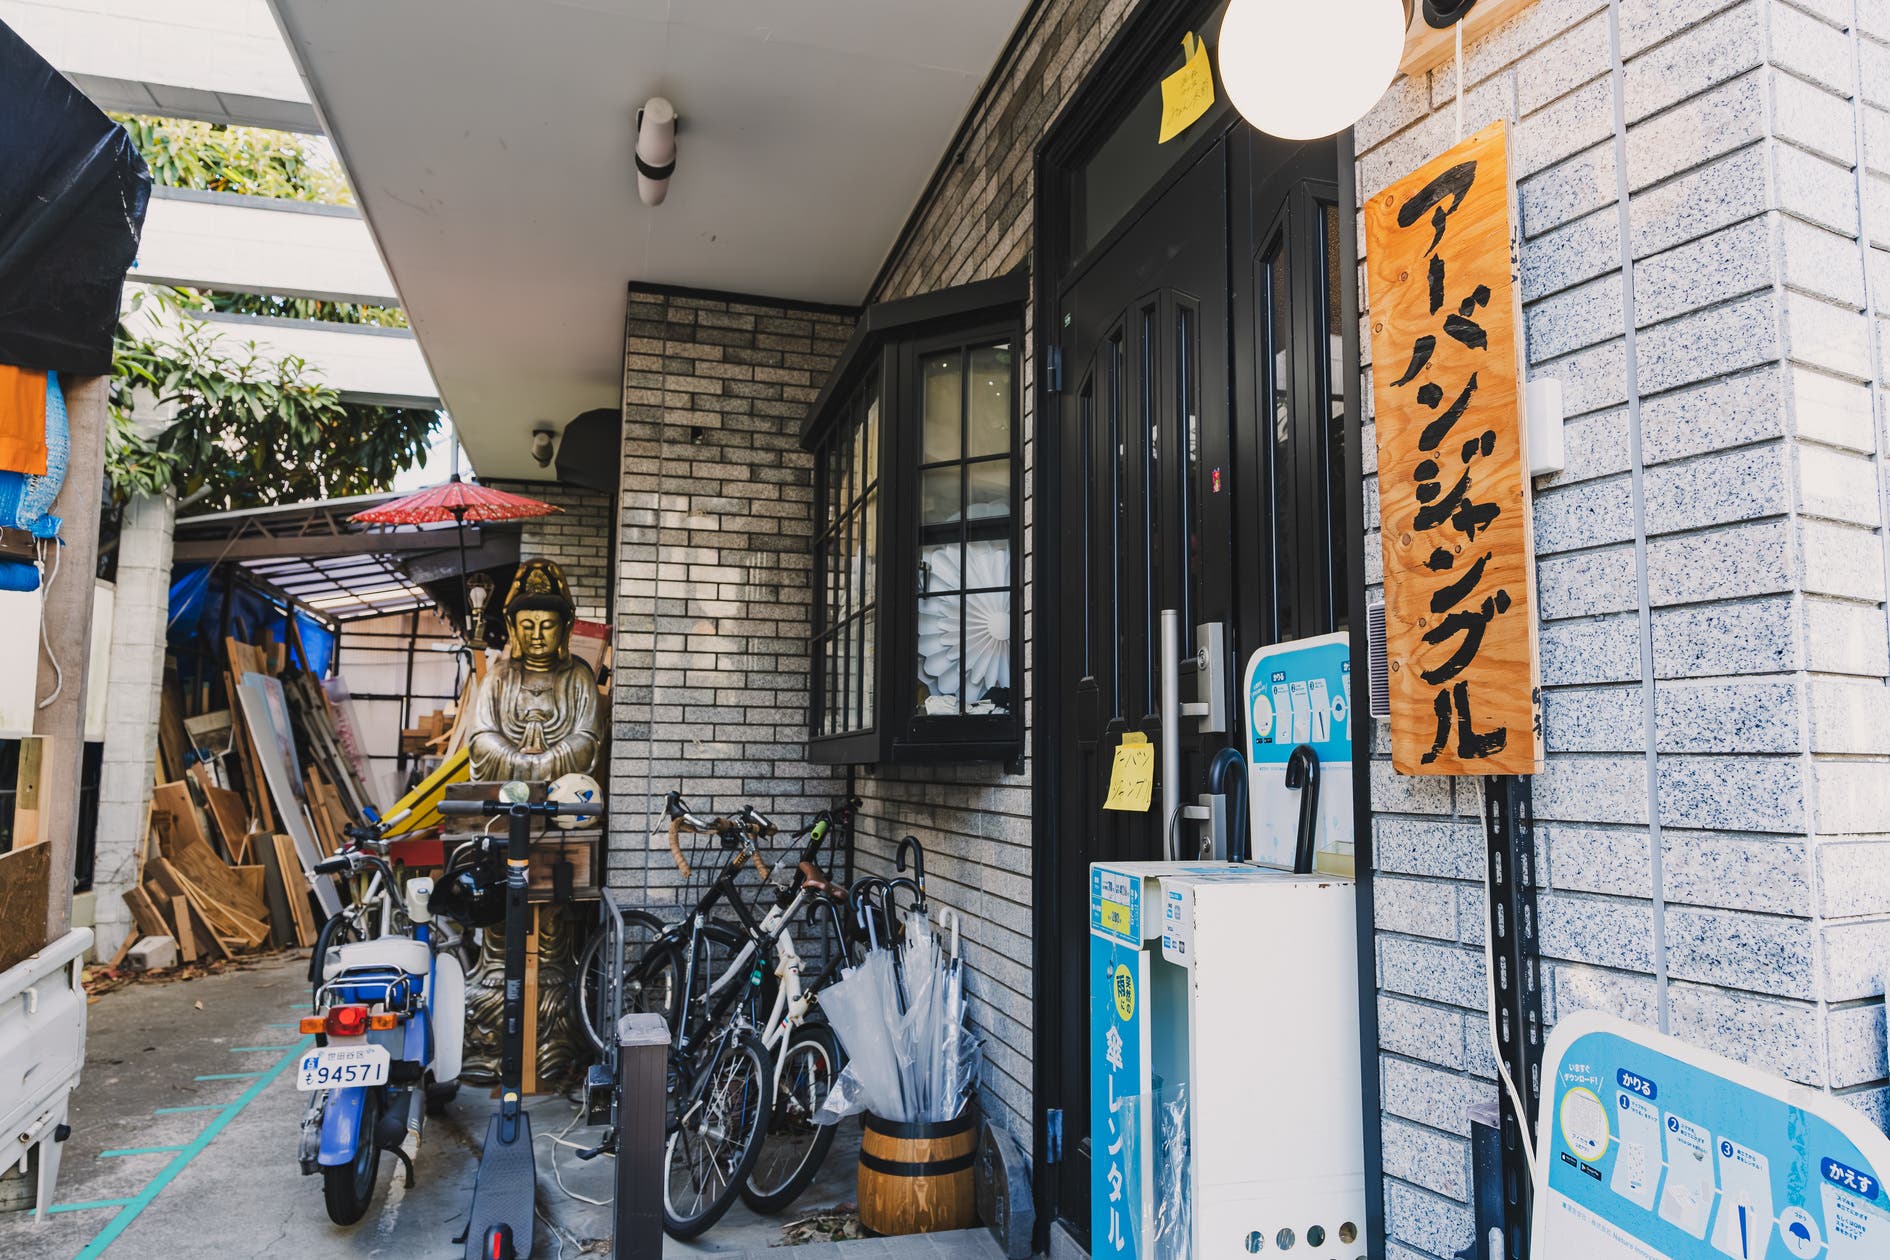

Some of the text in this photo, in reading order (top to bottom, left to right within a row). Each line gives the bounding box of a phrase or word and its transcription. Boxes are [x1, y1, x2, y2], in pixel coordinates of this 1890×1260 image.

[1390, 160, 1511, 765] アーバンジャングル
[318, 1063, 381, 1084] 94571
[1622, 1073, 1651, 1096] かりる
[1105, 1025, 1125, 1252] 傘レンタル
[1829, 1163, 1872, 1193] かえす
